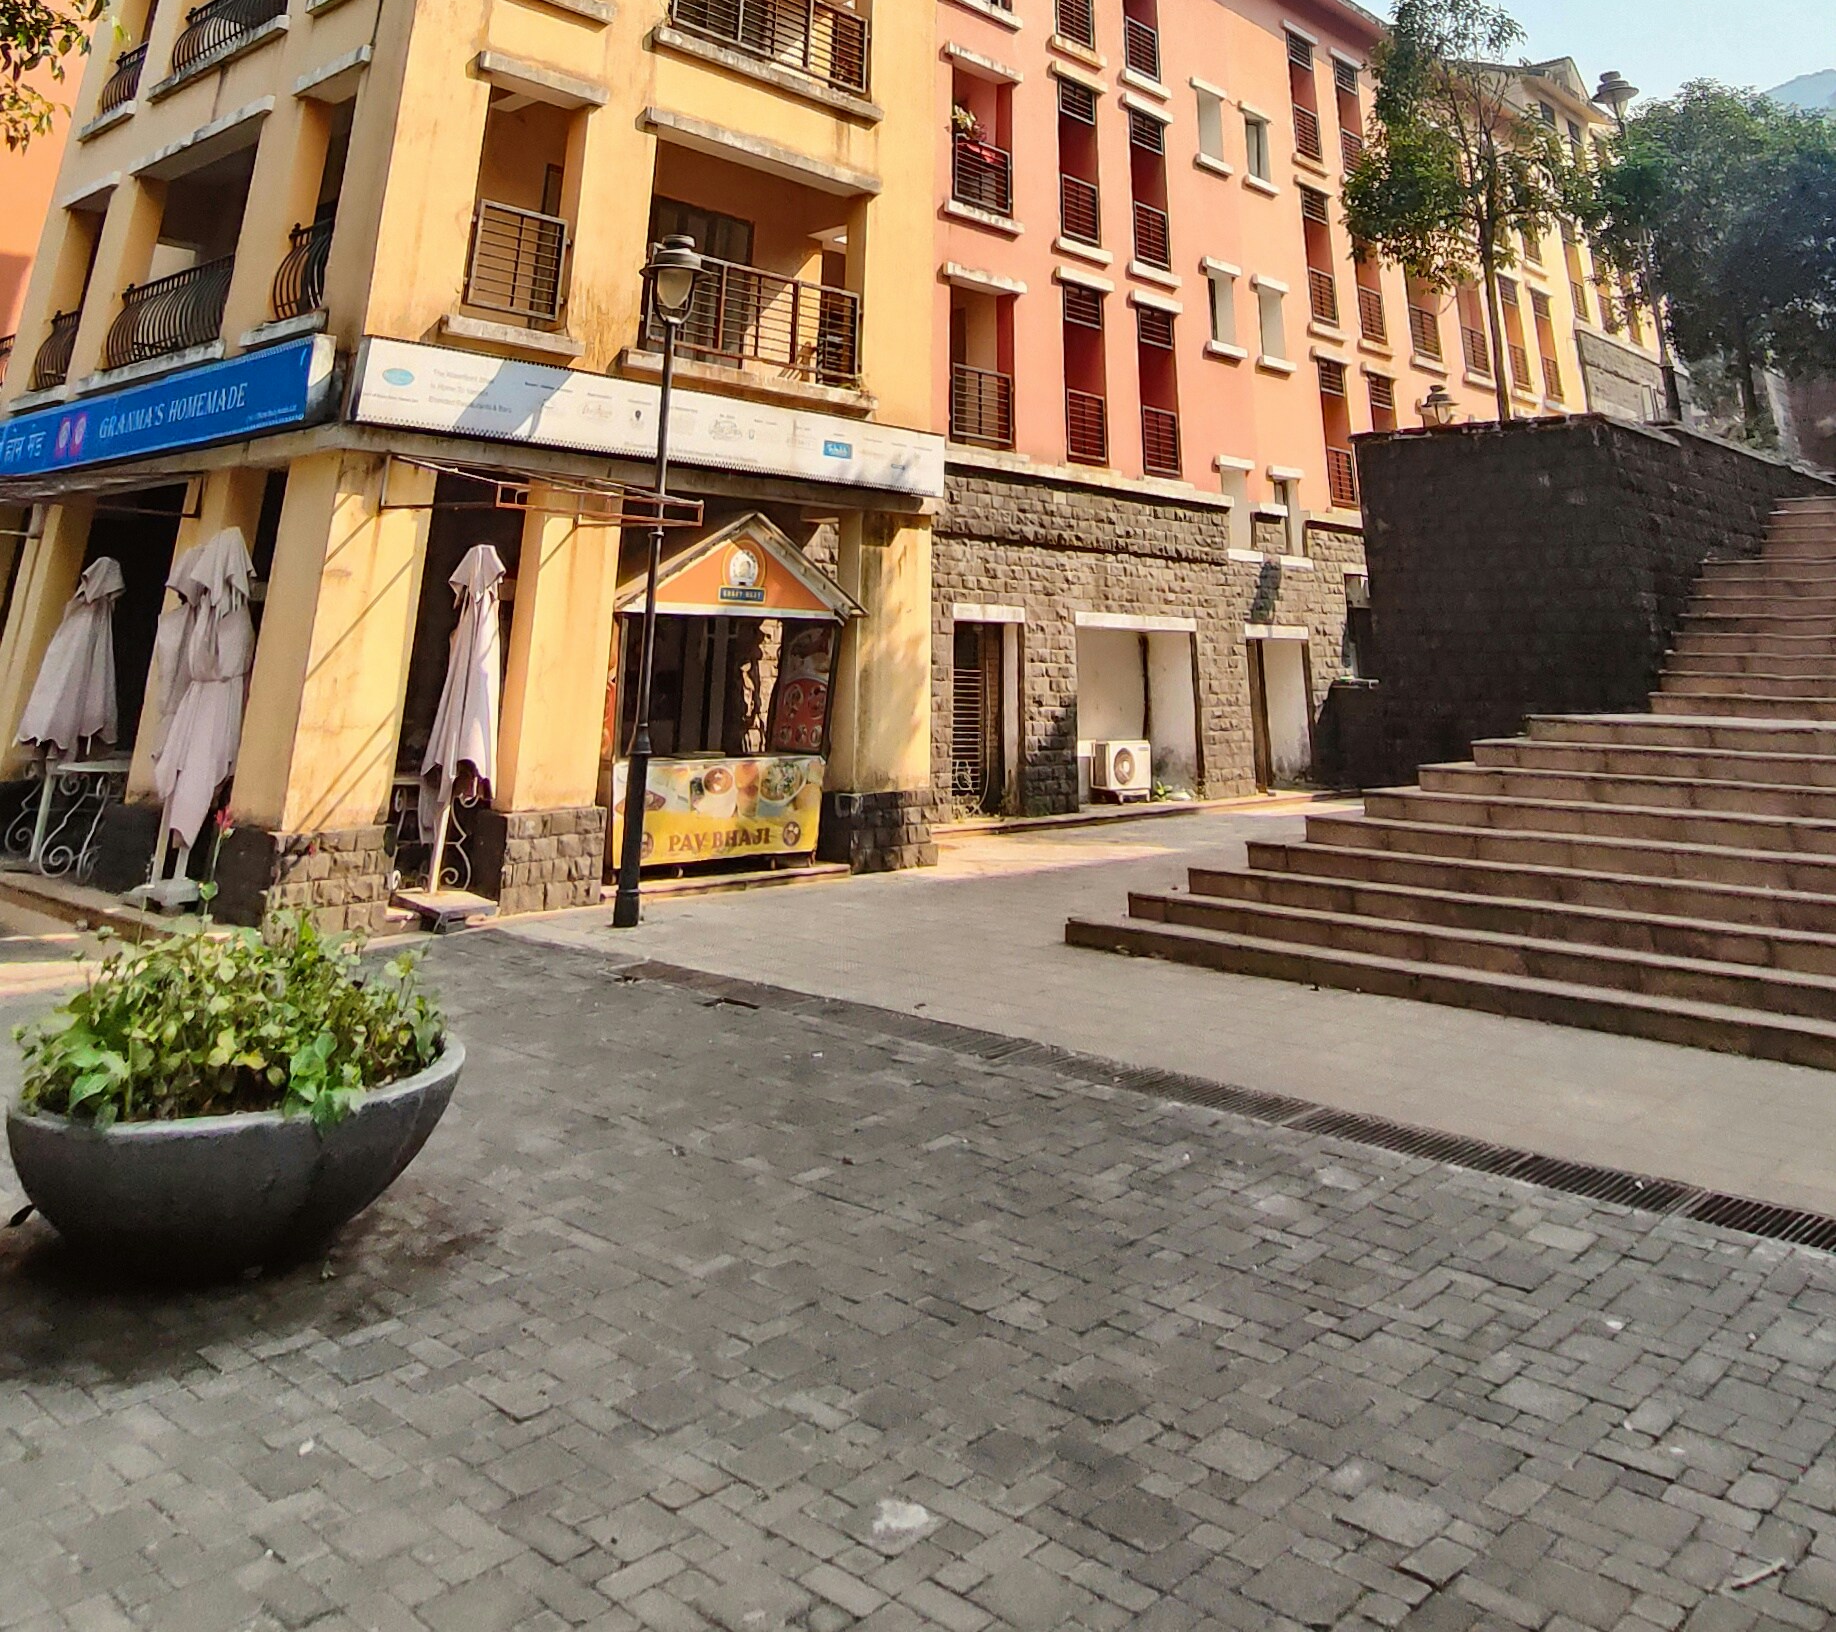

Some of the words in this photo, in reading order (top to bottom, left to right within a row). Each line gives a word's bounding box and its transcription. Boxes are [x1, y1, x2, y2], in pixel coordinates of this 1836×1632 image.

[99, 403, 165, 439] GRANMA'S
[168, 382, 248, 423] HOMEMADE
[668, 831, 709, 853] PAV
[712, 827, 771, 849] BHAJI
